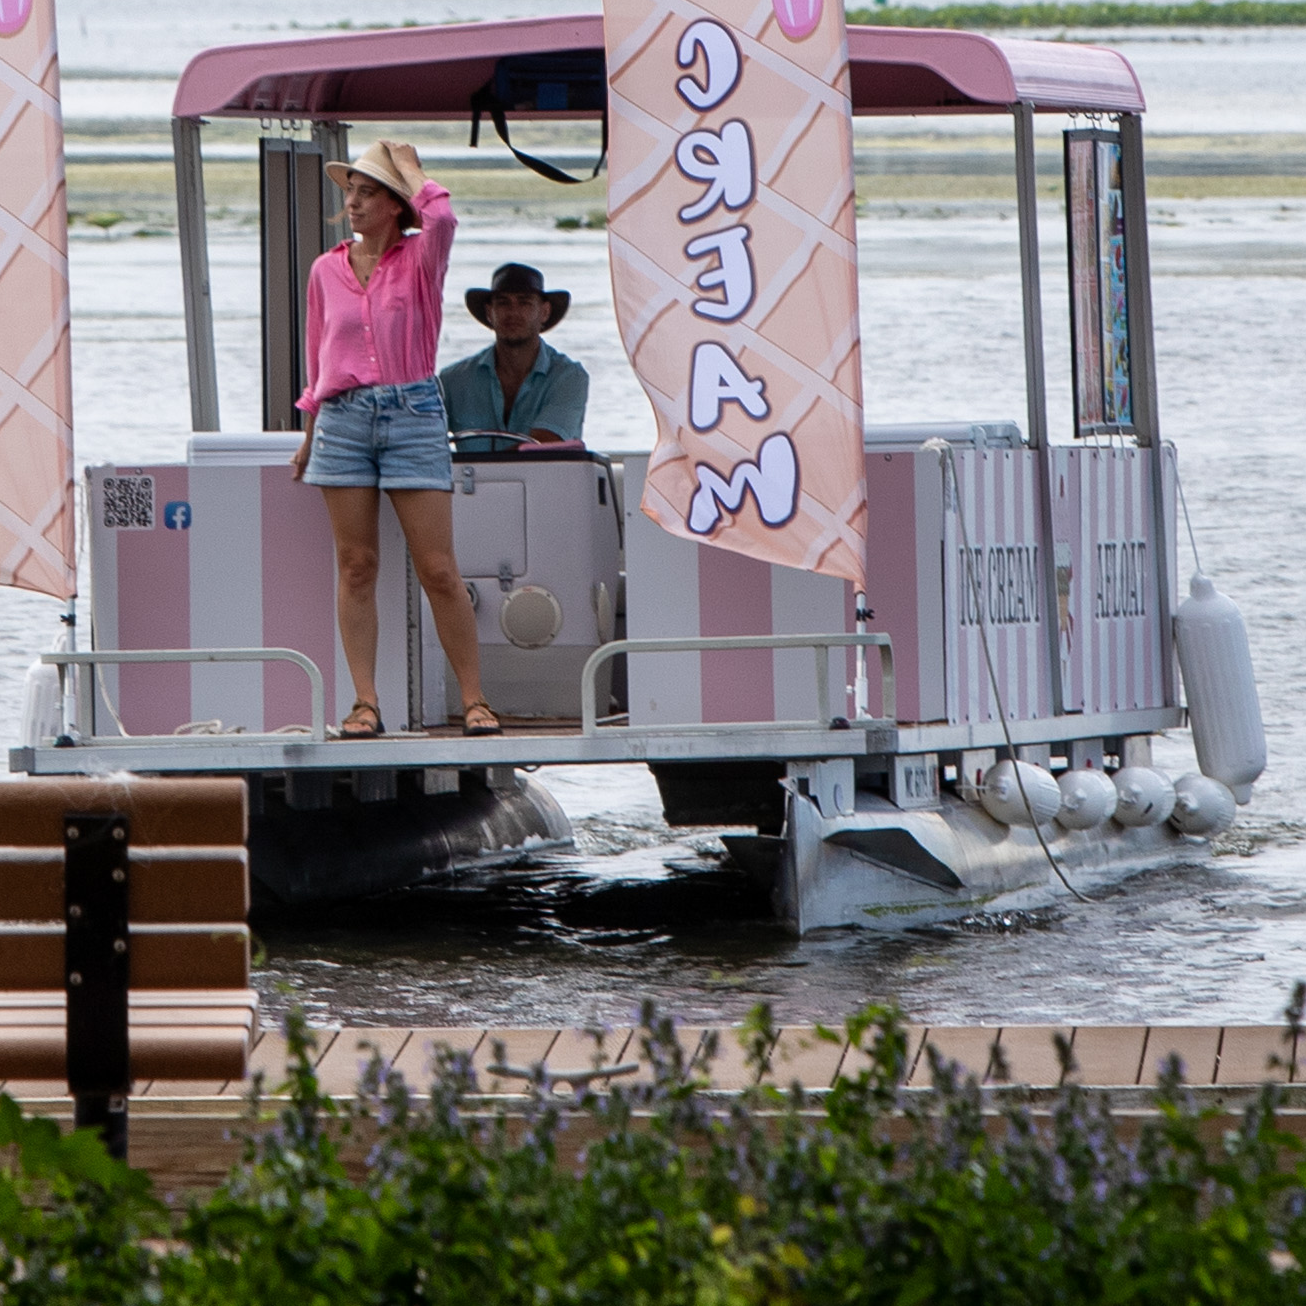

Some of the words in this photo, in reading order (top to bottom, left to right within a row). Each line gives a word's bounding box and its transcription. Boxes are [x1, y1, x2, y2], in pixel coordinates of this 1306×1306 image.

[958, 546, 984, 626] ICE
[988, 545, 1041, 625] CREAM
[1095, 541, 1147, 618] AFLOAT
